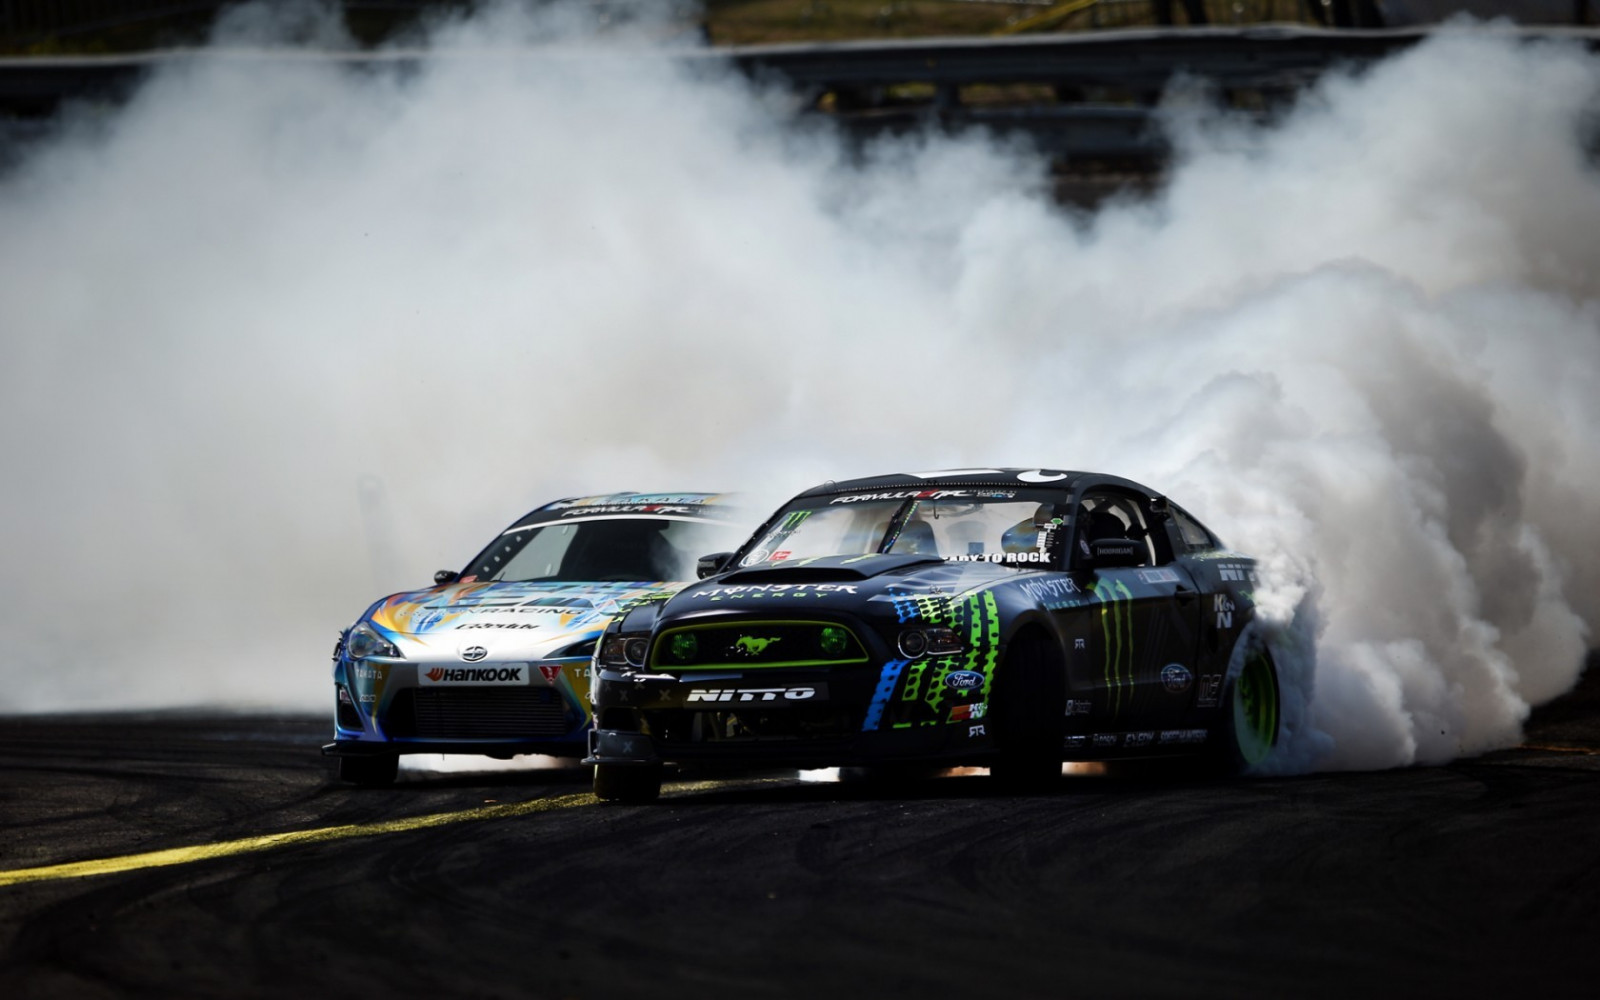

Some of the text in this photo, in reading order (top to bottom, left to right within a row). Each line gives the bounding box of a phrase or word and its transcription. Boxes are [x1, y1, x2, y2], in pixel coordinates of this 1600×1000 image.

[828, 490, 922, 505] FORMULA
[982, 553, 1003, 563] TO
[1006, 552, 1051, 563] ROCK
[692, 583, 858, 598] MONSTER
[710, 592, 827, 601] ENERGY
[1019, 577, 1081, 601] MONSTER
[952, 673, 977, 687] Ford
[686, 687, 816, 702] NITTO
